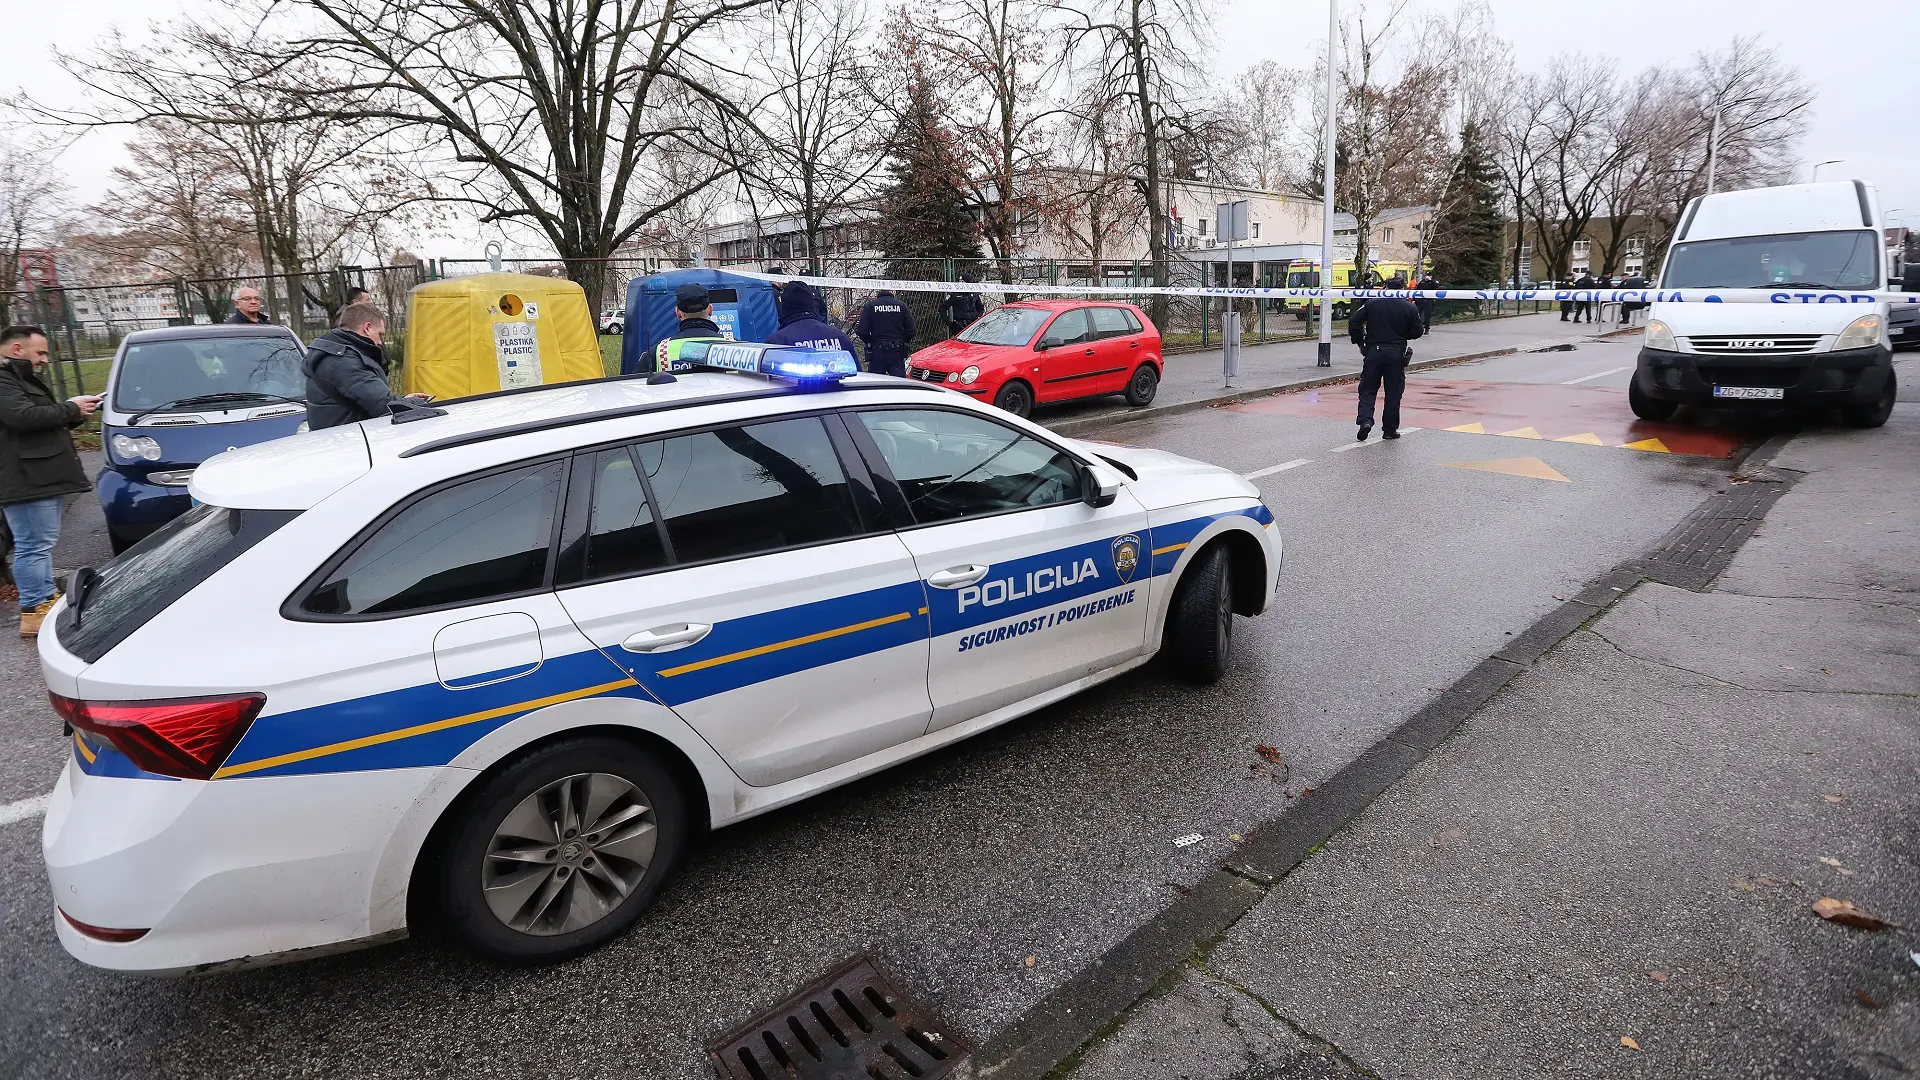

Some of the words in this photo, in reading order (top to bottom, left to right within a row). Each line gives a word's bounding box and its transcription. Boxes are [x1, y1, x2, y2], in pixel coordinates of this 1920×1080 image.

[874, 305, 901, 313] POLICIJA
[500, 338, 534, 346] PLASTIKA
[1727, 340, 1775, 348] IVECO
[504, 347, 533, 355] PLASTIC
[710, 346, 757, 370] POLICIJA
[1721, 387, 1735, 397] ZG
[1114, 536, 1139, 549] POLICIJA
[958, 557, 1100, 614] POLICIJA
[958, 616, 1047, 652] SIGURNOST
[1047, 613, 1055, 627] I
[1056, 589, 1136, 626] POVJERENJE
